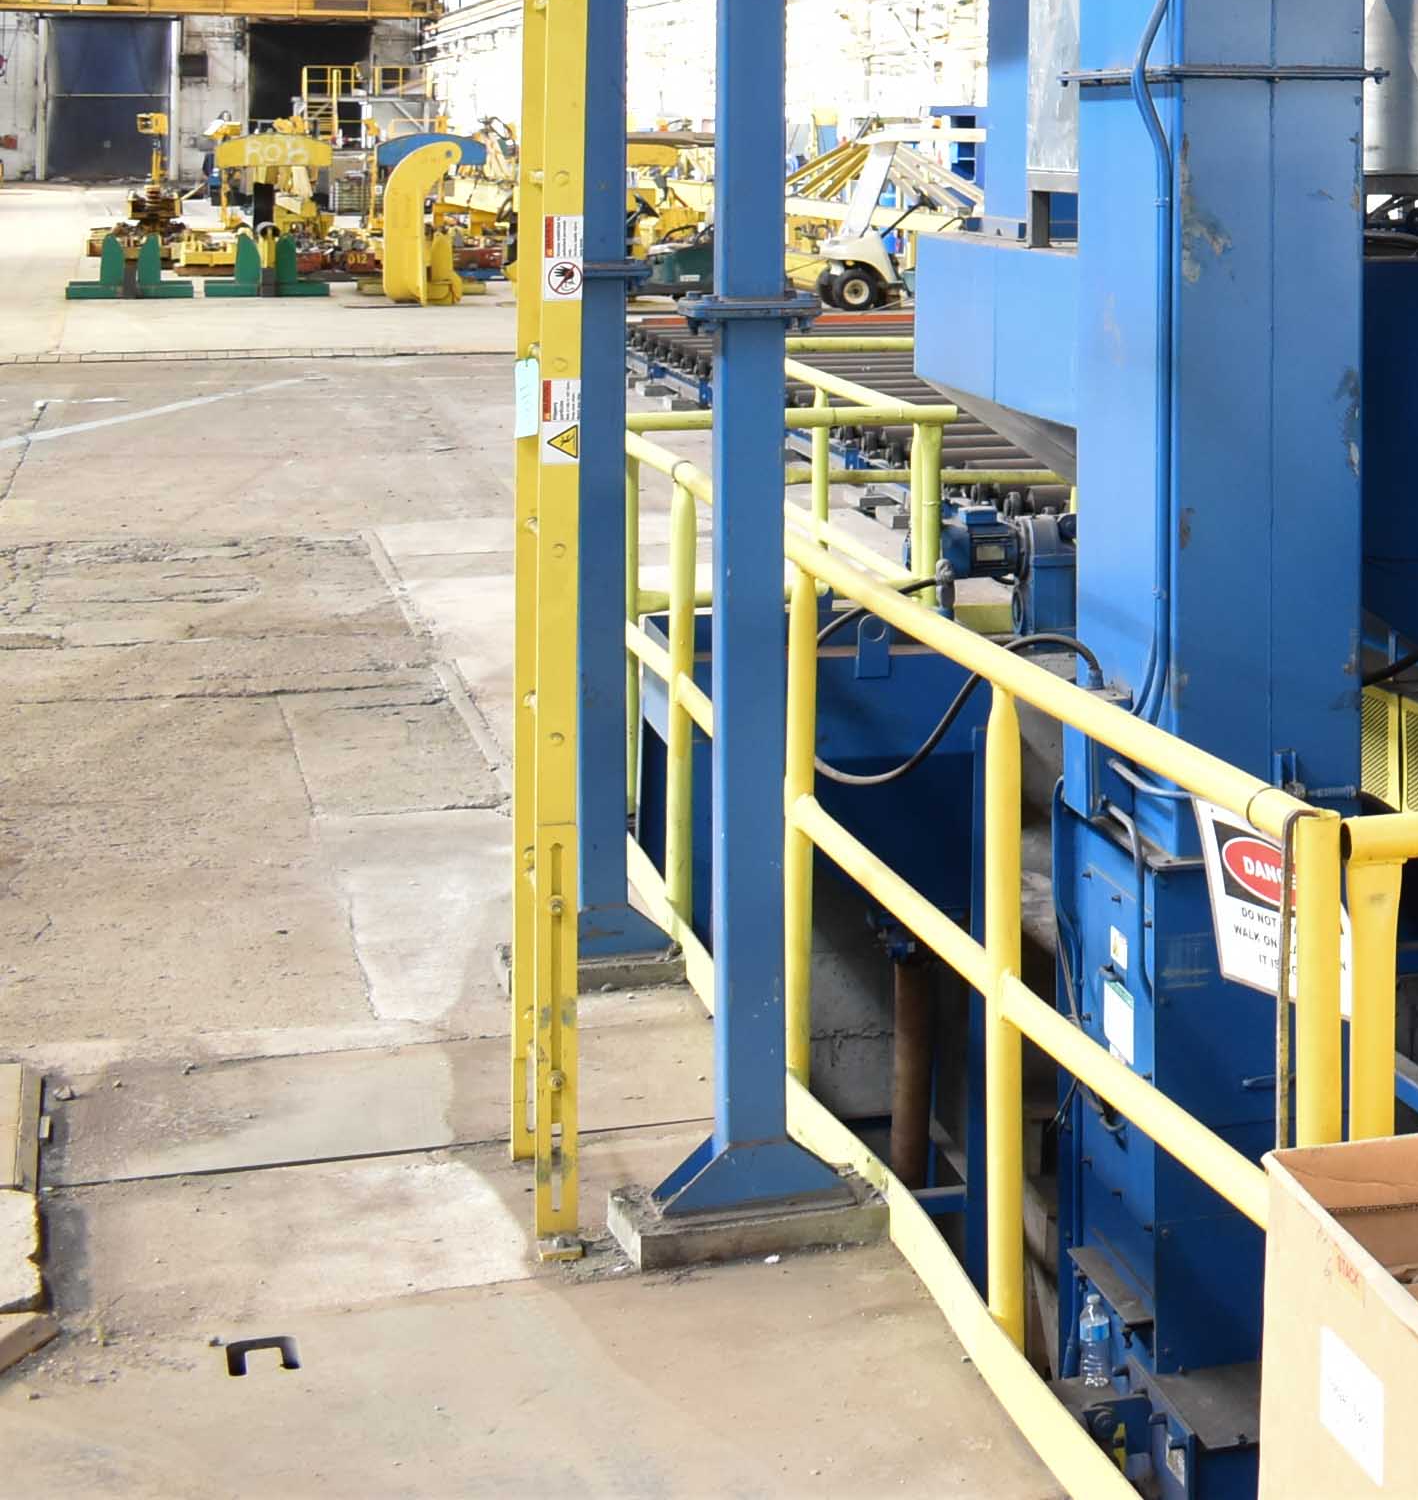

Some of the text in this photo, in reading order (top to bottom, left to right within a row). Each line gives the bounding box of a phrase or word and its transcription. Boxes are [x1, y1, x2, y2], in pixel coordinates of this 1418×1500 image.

[1241, 907, 1277, 927] DO NOT
[1234, 923, 1278, 948] WALK ON
